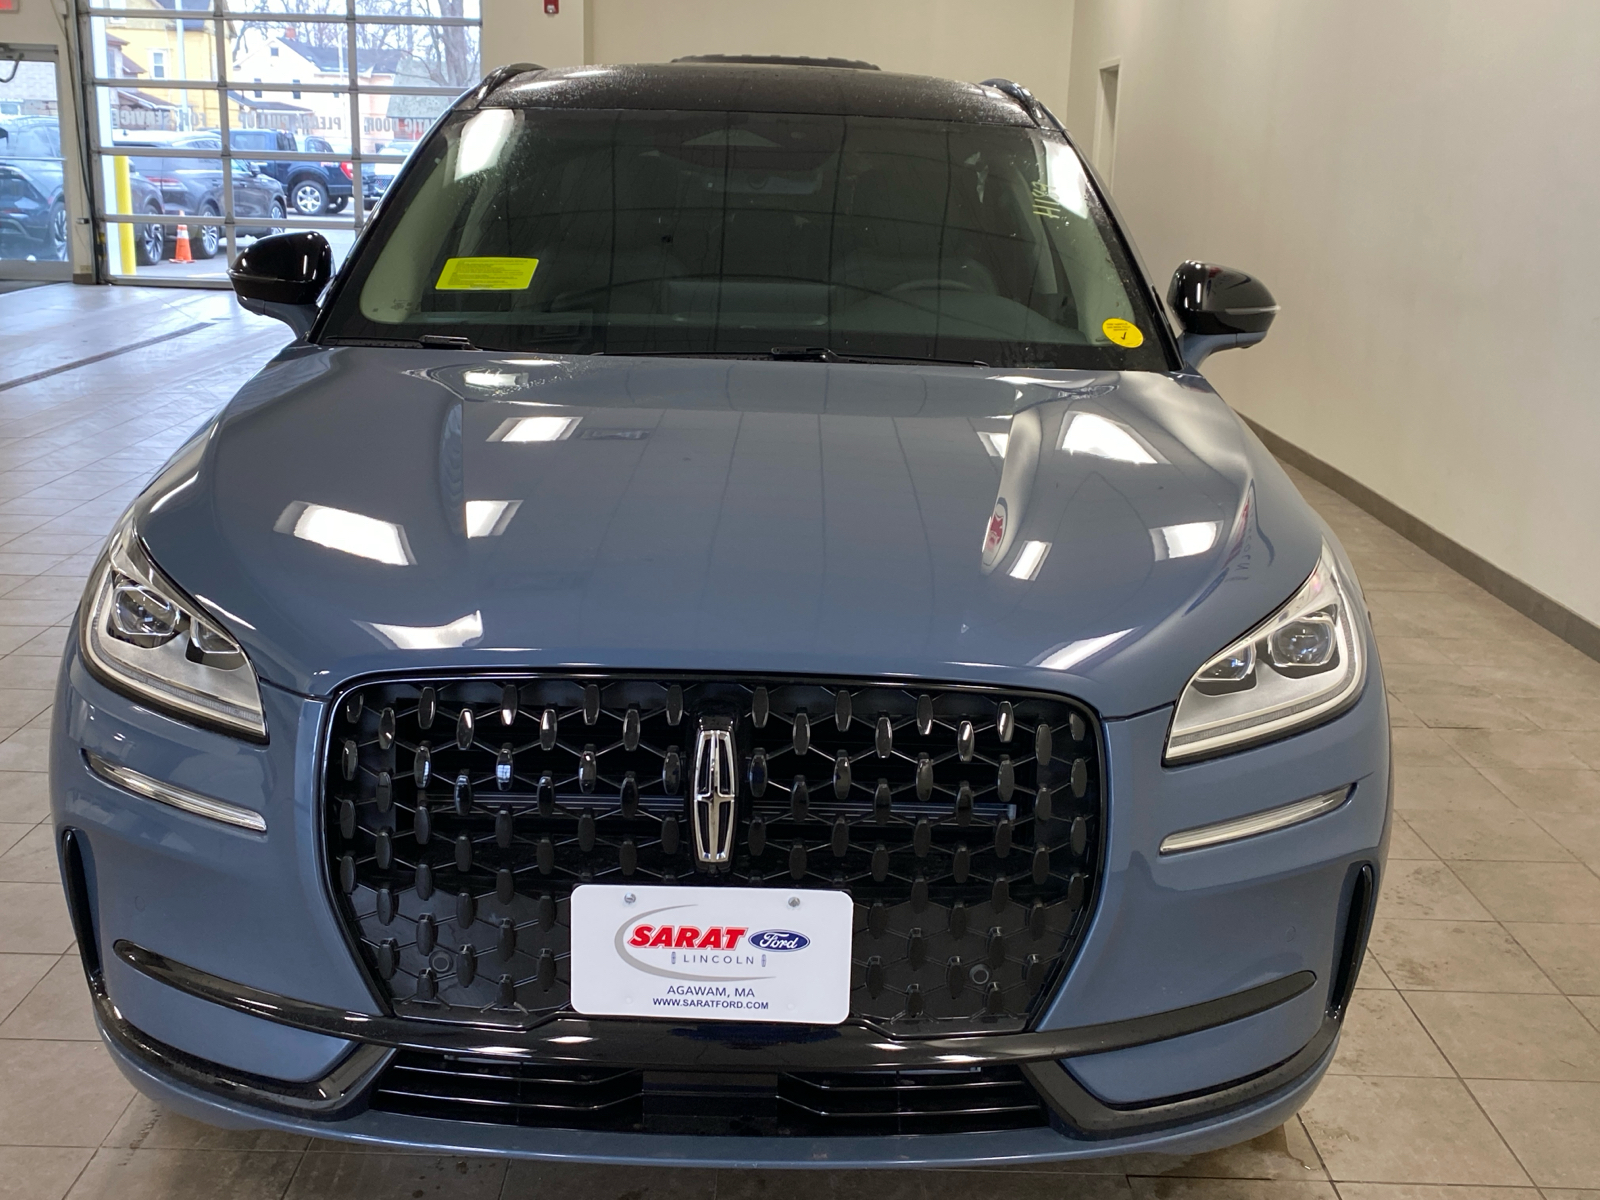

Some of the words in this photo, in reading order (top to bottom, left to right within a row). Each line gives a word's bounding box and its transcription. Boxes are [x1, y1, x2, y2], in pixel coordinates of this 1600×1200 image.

[627, 924, 748, 950] SARAT
[759, 932, 799, 949] Ford
[683, 954, 754, 965] LINCOLN
[667, 985, 731, 998] AGAWAM,
[734, 987, 755, 998] MA
[652, 998, 769, 1010] WWW.SARATFORD.COM
